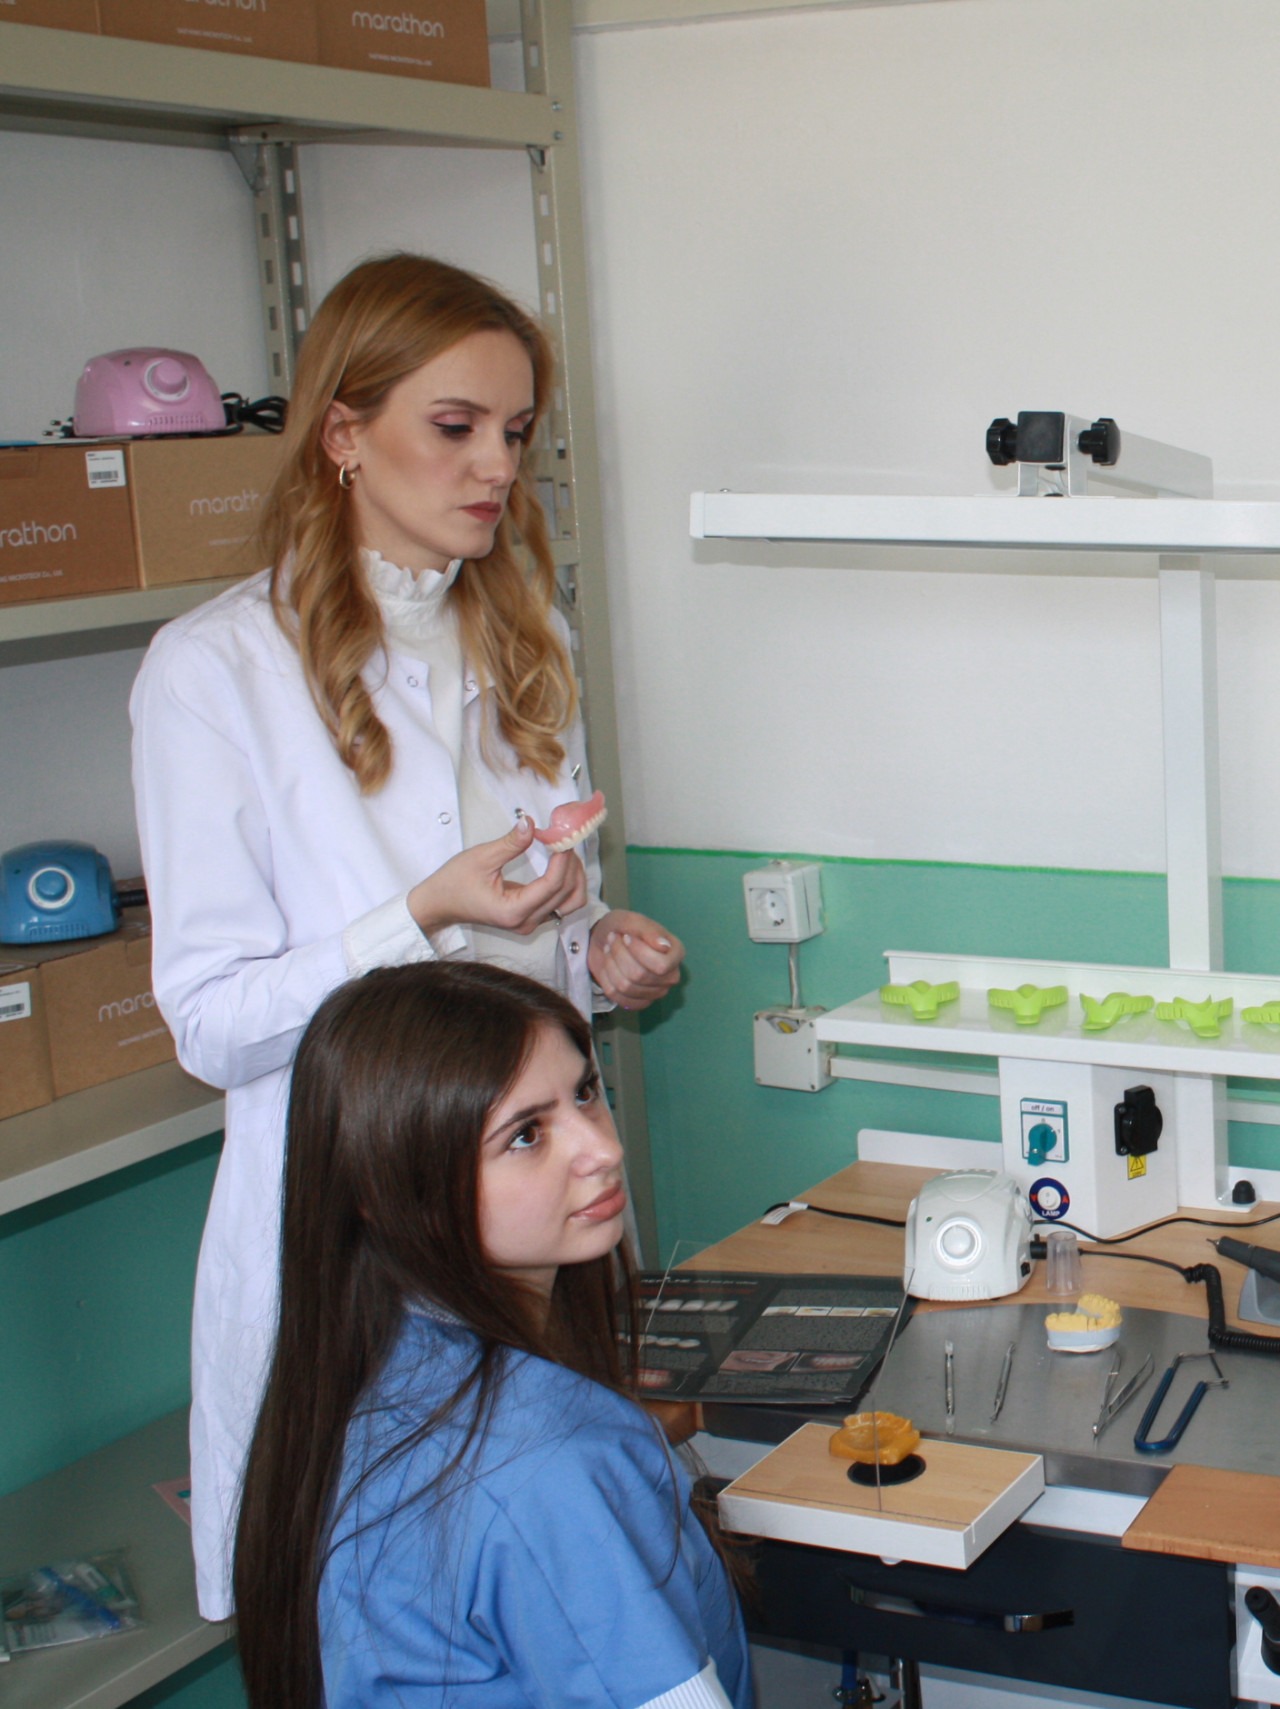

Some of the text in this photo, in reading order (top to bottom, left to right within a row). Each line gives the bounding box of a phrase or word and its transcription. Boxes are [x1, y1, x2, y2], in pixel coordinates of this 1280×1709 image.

[351, 11, 445, 38] marathon
[190, 488, 260, 516] marat
[0, 521, 77, 548] rathon
[98, 991, 155, 1022] mara
